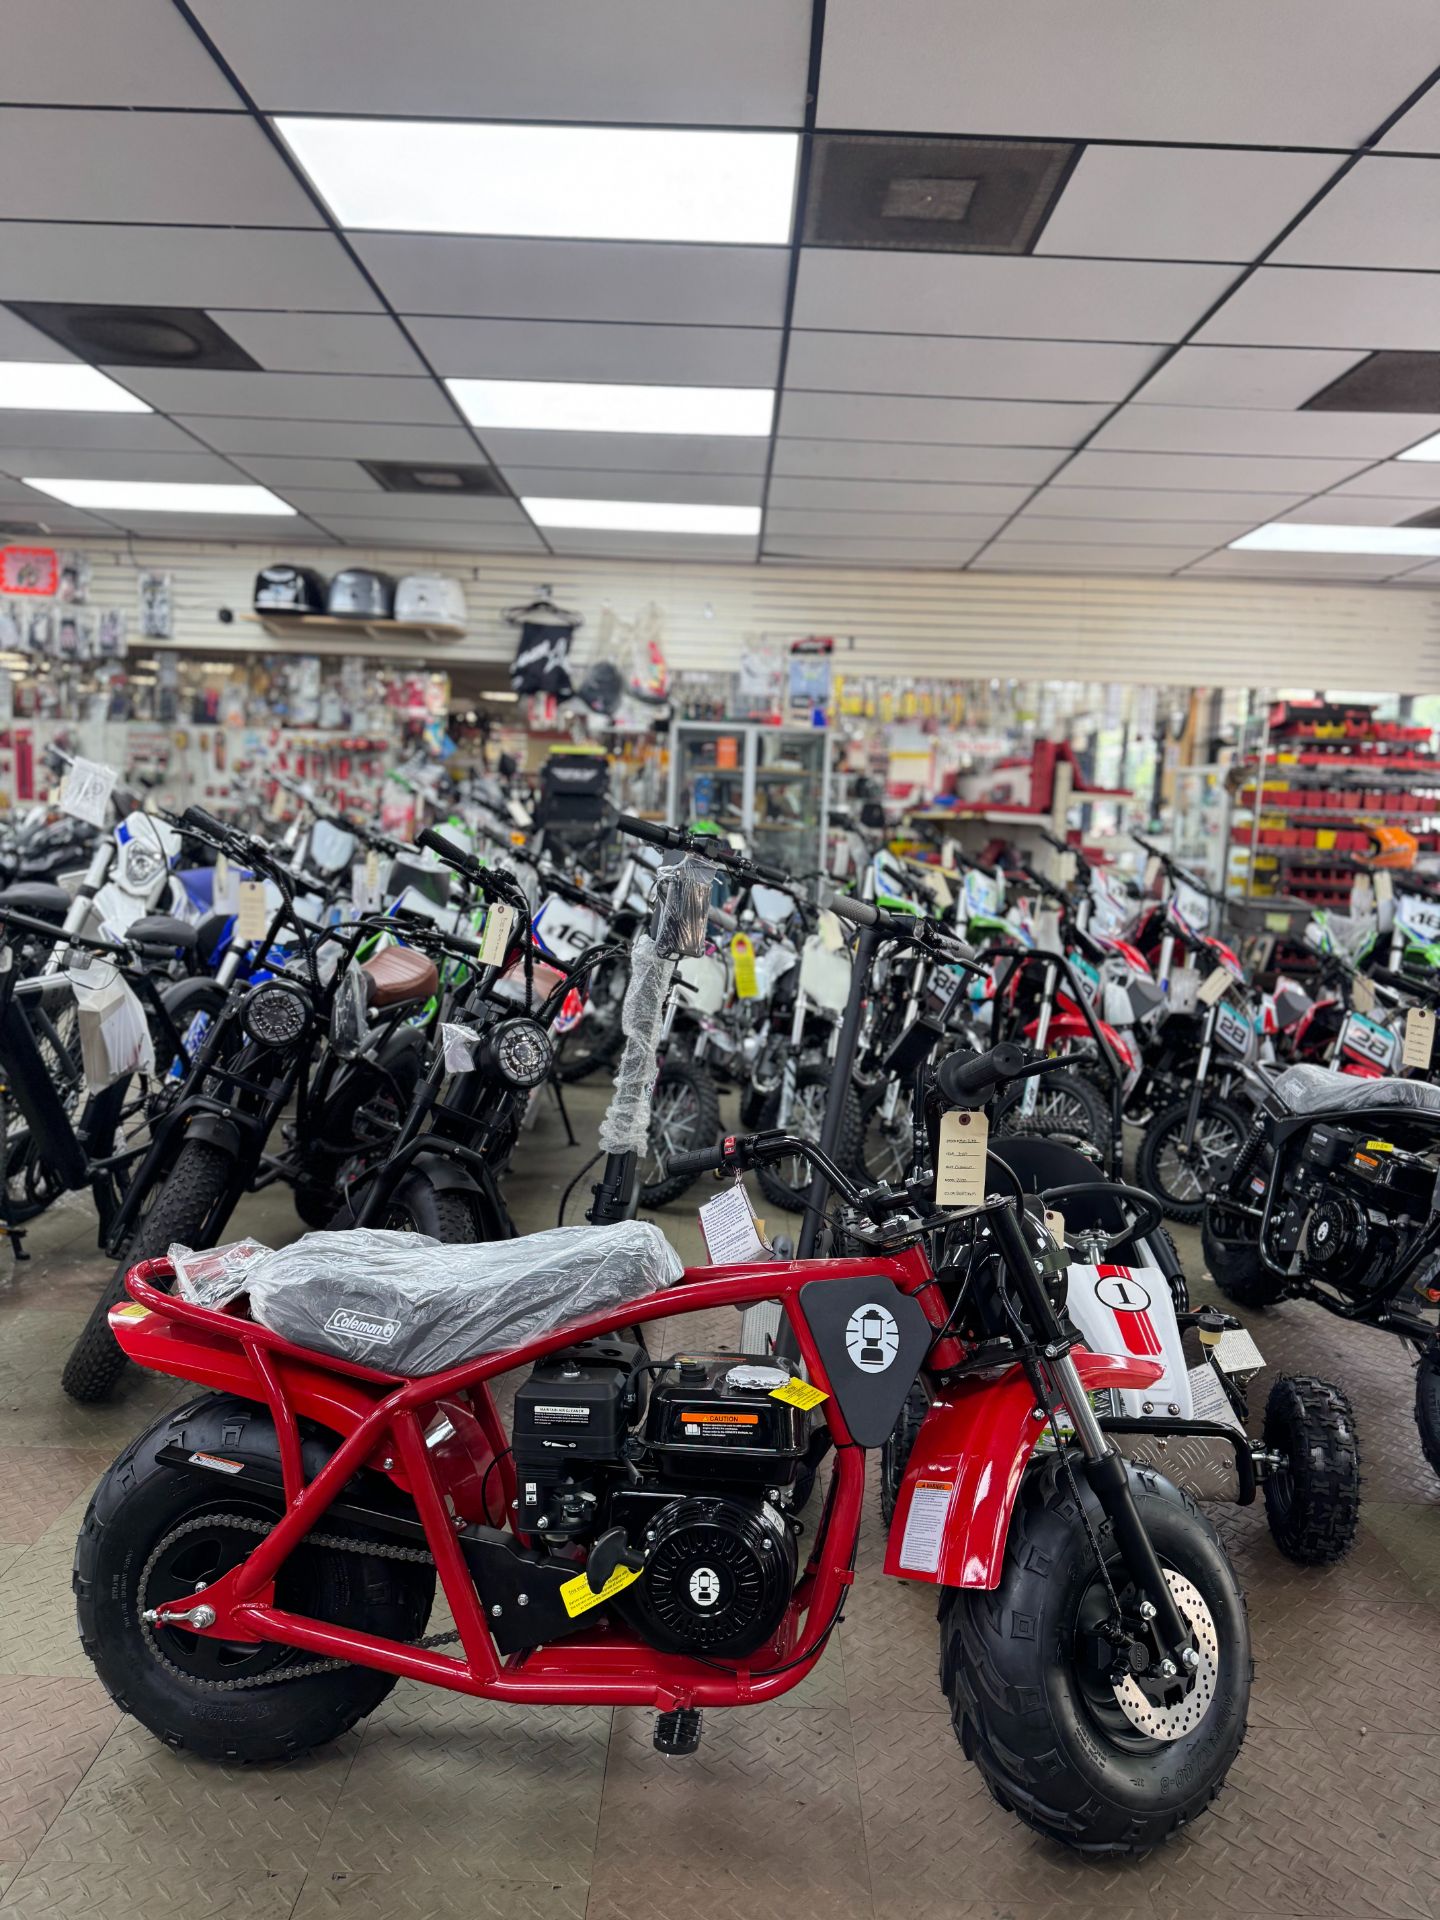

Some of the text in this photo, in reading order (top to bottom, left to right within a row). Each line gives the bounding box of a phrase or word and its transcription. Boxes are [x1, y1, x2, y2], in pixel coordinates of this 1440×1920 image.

[557, 924, 595, 951] 16
[1220, 1016, 1246, 1045] 28
[1349, 1027, 1389, 1058] 28
[1112, 1283, 1136, 1305] 1
[333, 1312, 383, 1336] Coleman
